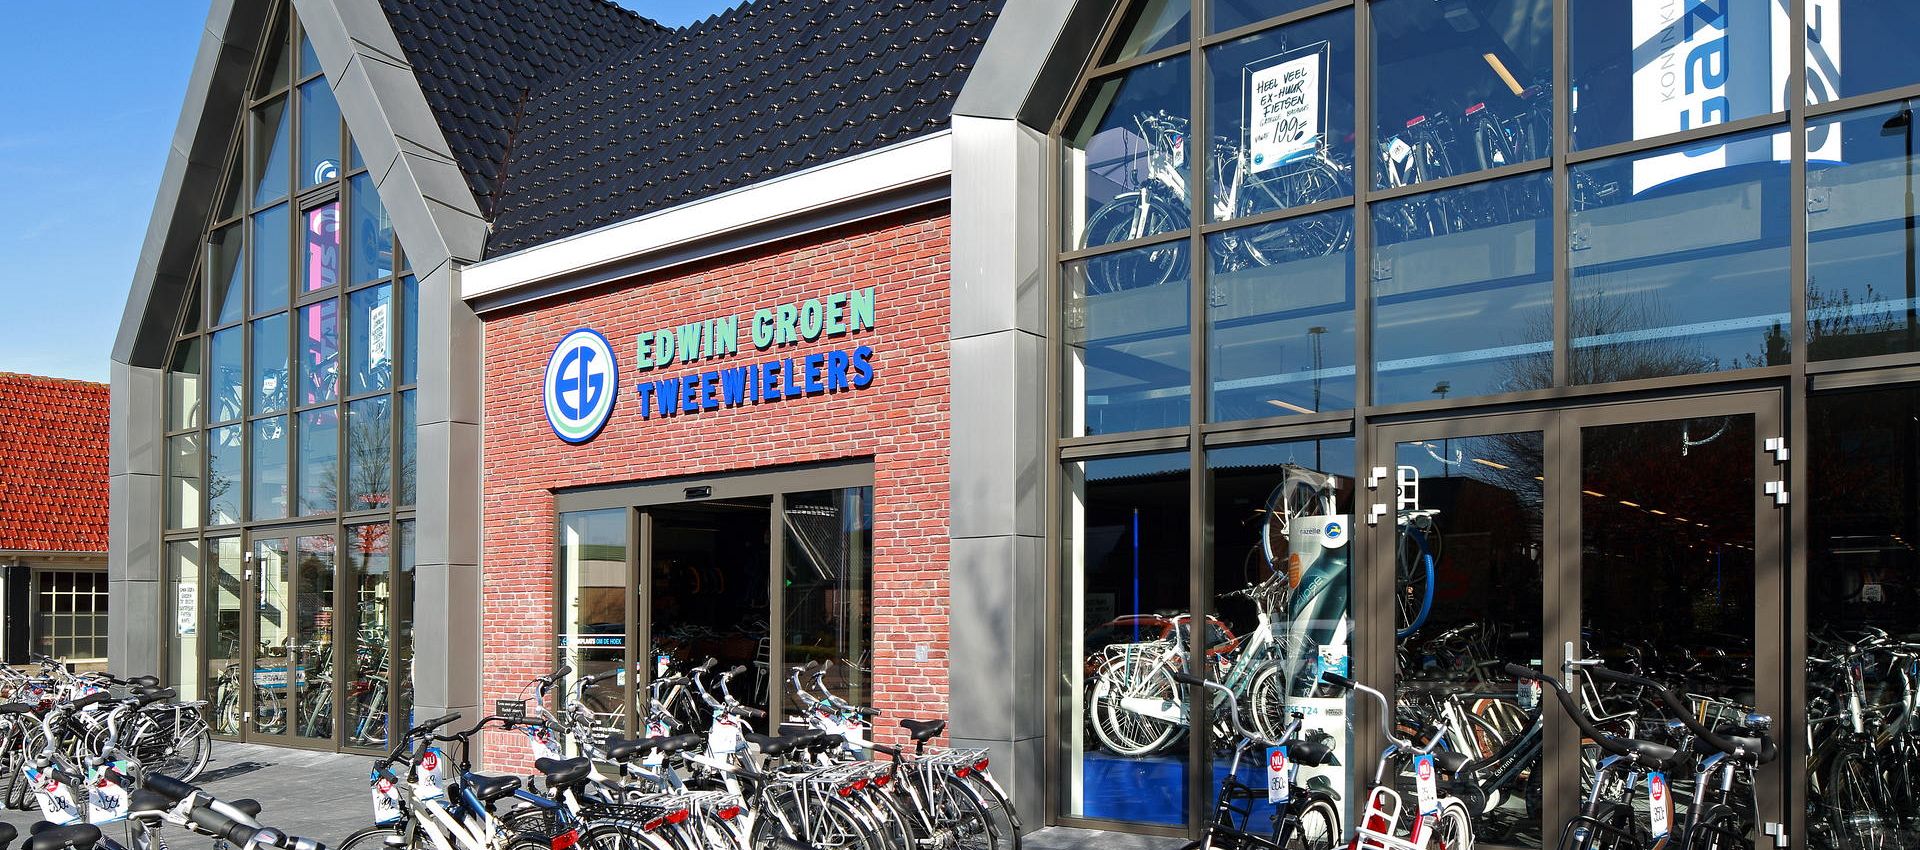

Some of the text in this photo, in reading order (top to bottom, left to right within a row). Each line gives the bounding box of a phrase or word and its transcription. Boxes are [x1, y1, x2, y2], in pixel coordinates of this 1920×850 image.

[1256, 67, 1308, 94] HEEL VEEL
[1260, 80, 1305, 106] EX-HUUR
[1263, 94, 1305, 118] FIETSEN
[636, 287, 876, 370] EDWIN GROEN
[555, 345, 605, 421] EG
[636, 345, 874, 418] TWEEWIELERS
[1301, 706, 1318, 715] T24
[1271, 753, 1283, 766] NÚ
